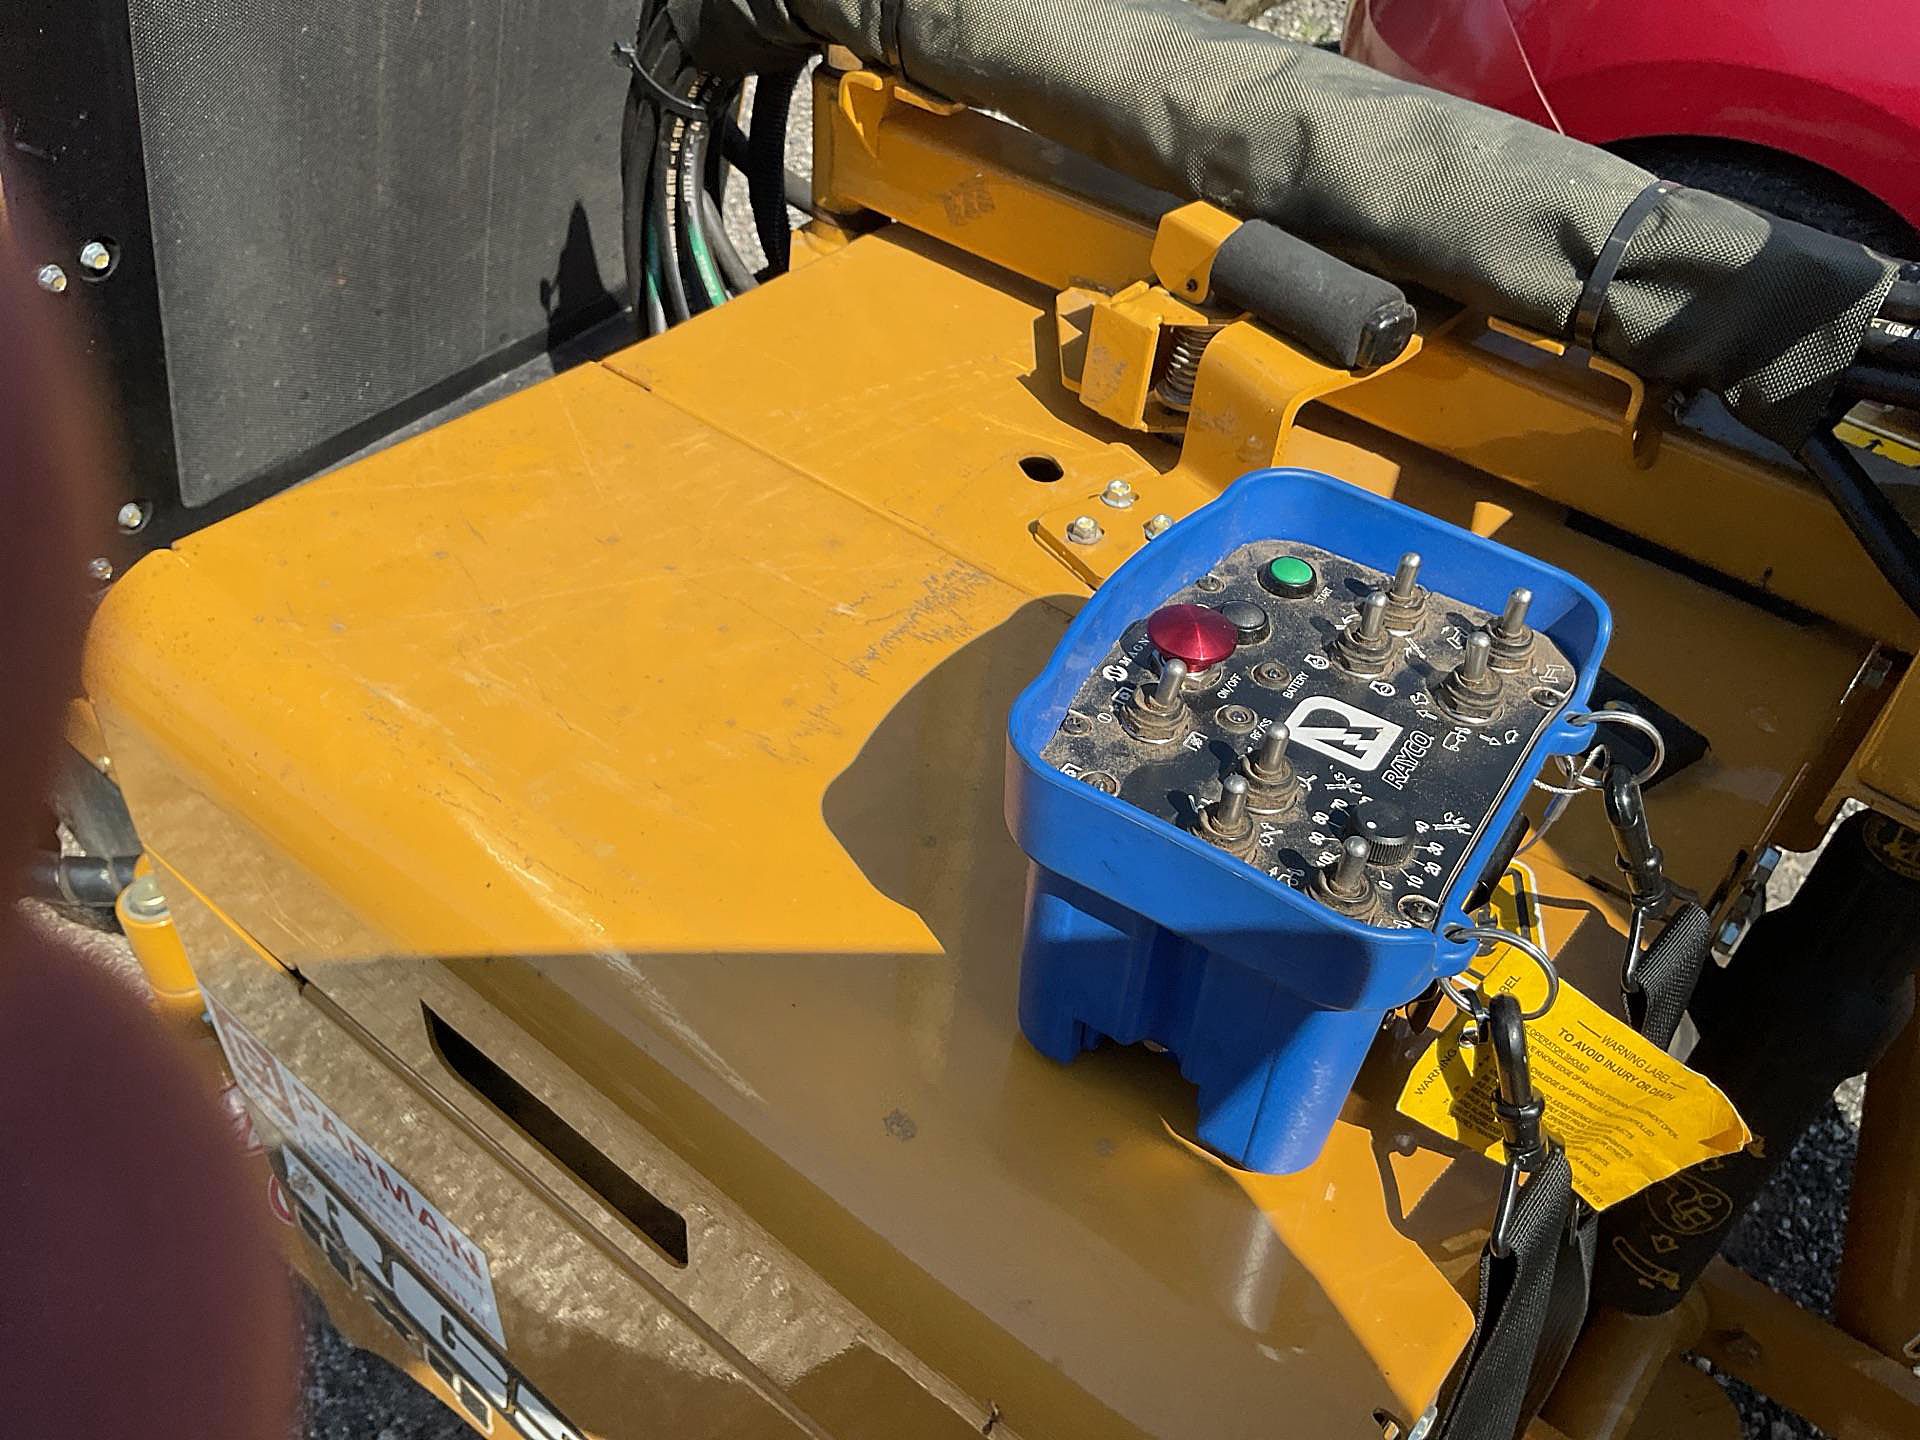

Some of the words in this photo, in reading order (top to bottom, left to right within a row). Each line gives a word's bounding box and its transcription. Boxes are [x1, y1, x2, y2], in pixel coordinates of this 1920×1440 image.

[1315, 586, 1333, 604] START
[1216, 673, 1242, 699] ON/OFF
[1282, 670, 1309, 699] BATTERY
[1250, 717, 1273, 741] RF/SS
[1381, 730, 1432, 791] RAYCO
[1311, 811, 1330, 825] 80
[1414, 820, 1430, 834] 40
[1316, 851, 1336, 868] 100
[1424, 861, 1442, 877] 20
[1378, 880, 1393, 890] 0
[1406, 874, 1424, 889] 10
[1500, 975, 1521, 992] BEL
[1530, 1028, 1566, 1054] OPERATOR
[1565, 1051, 1590, 1074] SHOULD
[1601, 1034, 1647, 1069] WARNING
[1644, 1064, 1671, 1084] LABEL
[1414, 1049, 1458, 1096] WARNING
[1535, 1048, 1574, 1077] KNOWLEDGE
[1571, 1073, 1580, 1082] OF
[1558, 1027, 1574, 1042] TO
[1572, 1040, 1605, 1063] AVOID
[1603, 1059, 1637, 1083] INJURY
[1636, 1080, 1649, 1090] OR
[1648, 1087, 1676, 1102] DEATH
[1530, 1067, 1559, 1089] OWLEDGE
[294, 1085, 482, 1280] PARMAN
